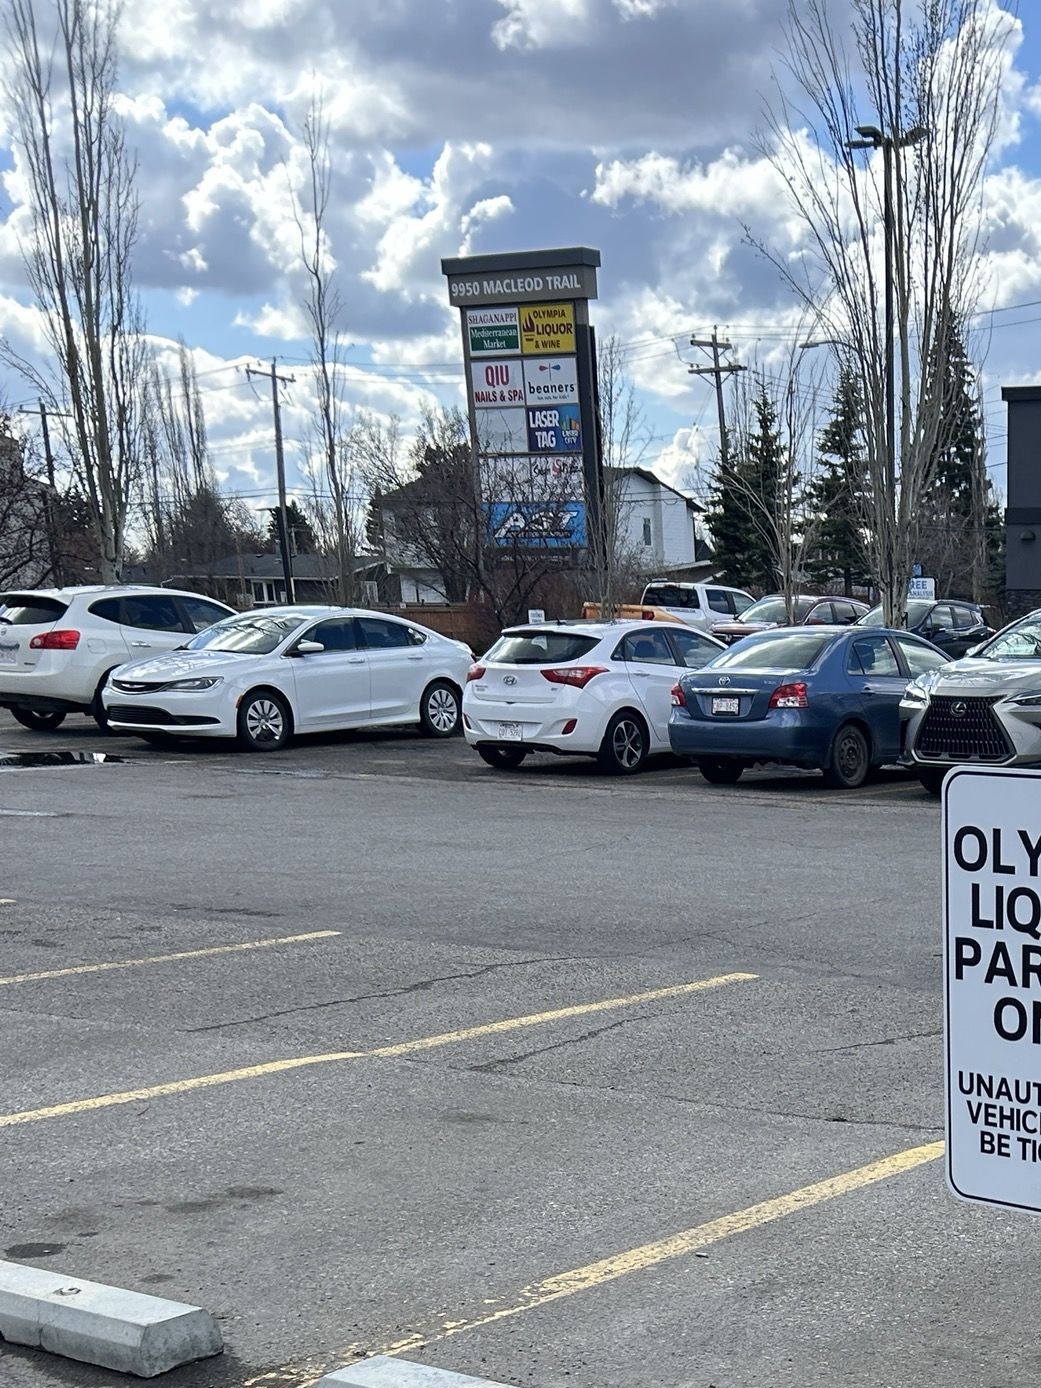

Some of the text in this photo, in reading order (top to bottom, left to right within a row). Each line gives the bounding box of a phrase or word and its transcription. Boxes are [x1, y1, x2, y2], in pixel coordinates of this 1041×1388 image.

[451, 274, 581, 297] 9950 MACLEOD TRAIL
[468, 312, 517, 325] SHAGANAPPI
[533, 309, 566, 320] OLYMPIA
[470, 327, 517, 339] Mediterranean
[536, 323, 573, 336] LIQUOR
[483, 339, 507, 349] Market
[535, 339, 561, 349] & WINE
[485, 365, 510, 388] QIU
[528, 381, 575, 394] beaners
[475, 389, 524, 403] NAILS & SPA
[529, 410, 560, 428] LASER
[535, 431, 556, 449] TAG
[979, 1130, 1011, 1158] BE
